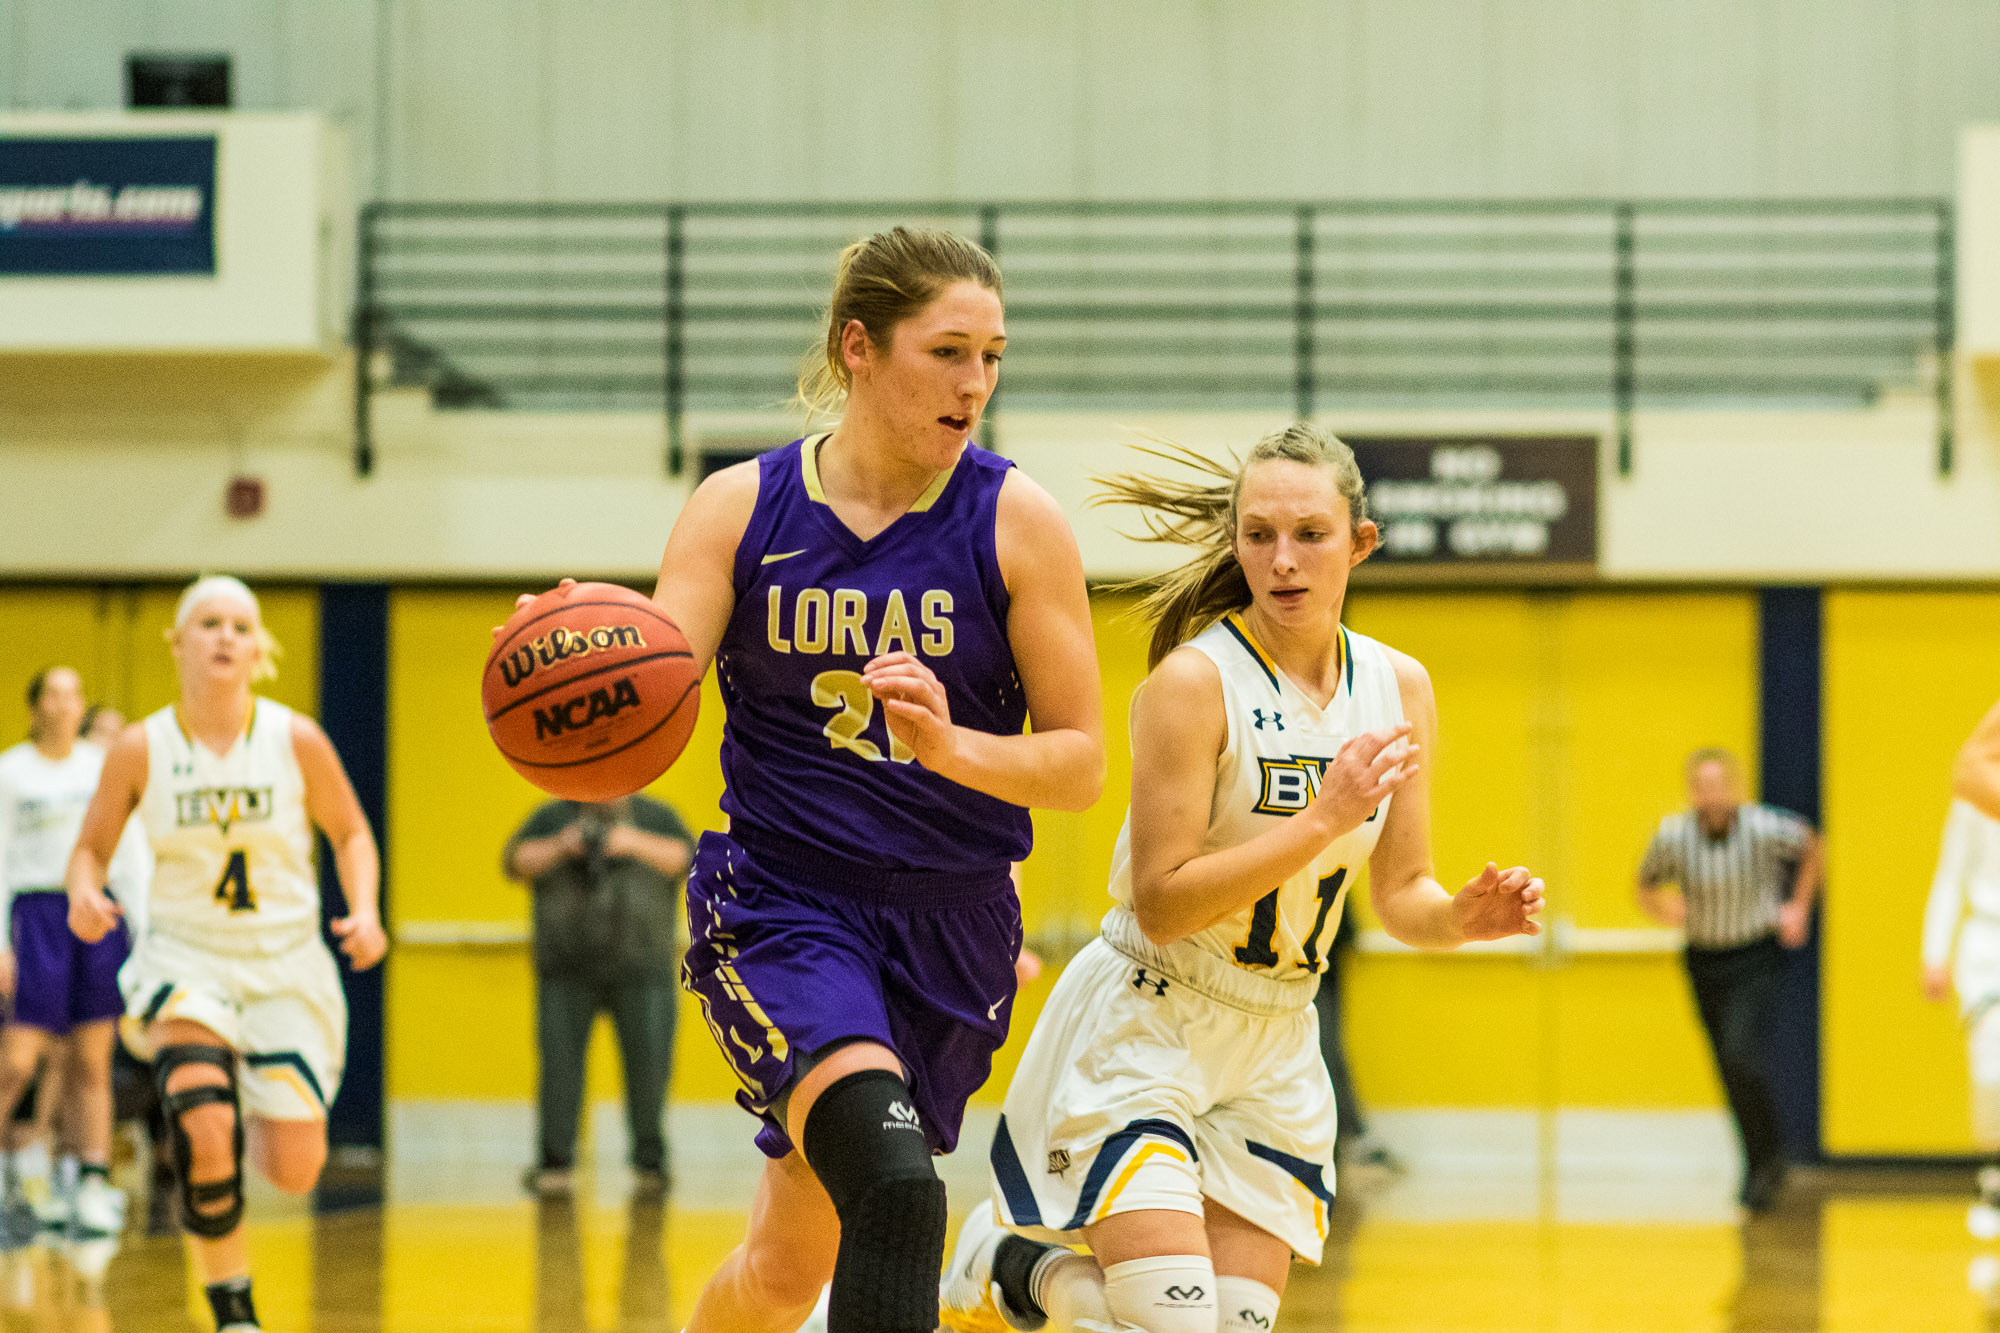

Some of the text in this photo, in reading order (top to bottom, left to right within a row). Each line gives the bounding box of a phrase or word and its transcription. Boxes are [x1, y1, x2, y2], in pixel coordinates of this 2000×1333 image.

[768, 585, 954, 657] LORAS
[500, 626, 647, 688] Wilson
[533, 678, 641, 740] NCAA
[811, 669, 916, 765] 2
[215, 848, 259, 916] 4
[1233, 864, 1348, 974] 11
